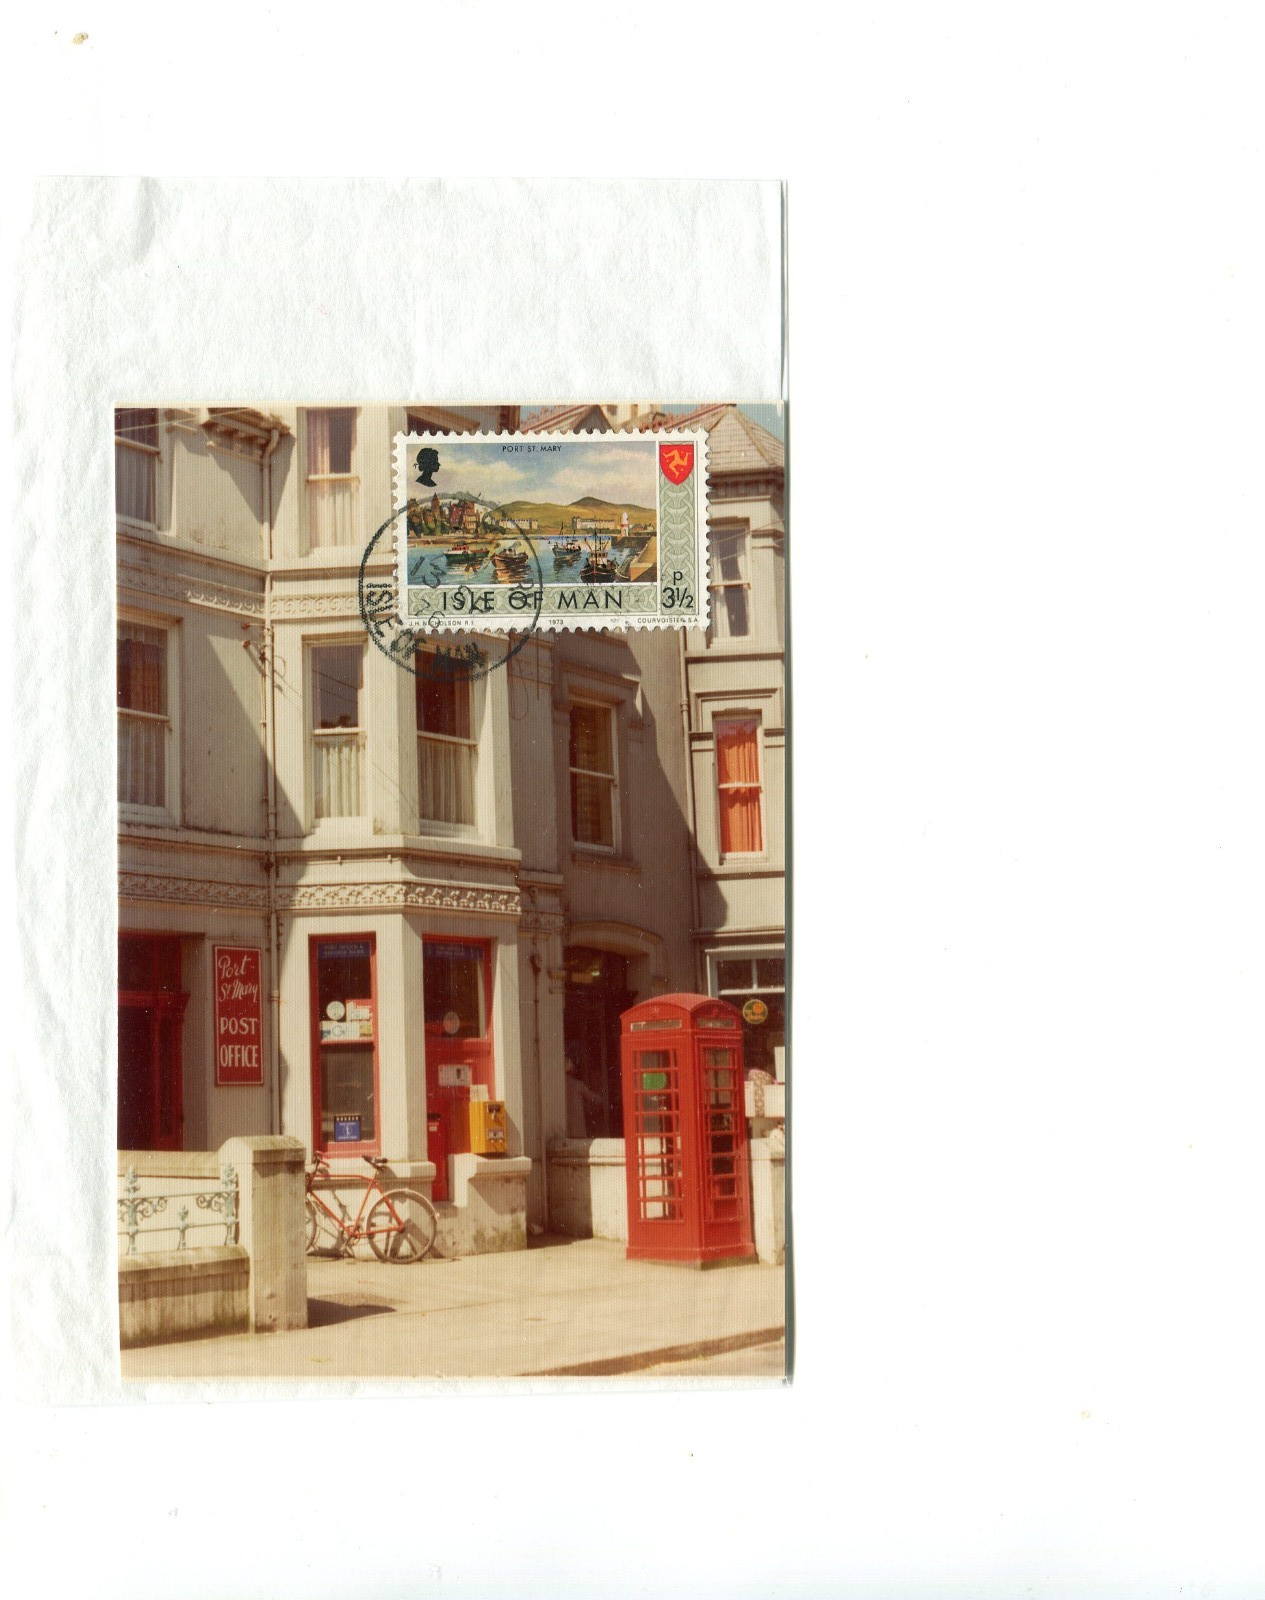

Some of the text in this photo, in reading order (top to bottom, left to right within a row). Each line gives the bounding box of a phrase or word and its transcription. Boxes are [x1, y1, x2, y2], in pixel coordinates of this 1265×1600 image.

[502, 445, 523, 453] PORT
[540, 445, 562, 453] MARY
[442, 590, 498, 610] ISLE
[508, 590, 543, 610] OF
[558, 590, 622, 609] MAN
[218, 954, 251, 979] Port
[231, 980, 258, 1003] Mary
[220, 1017, 258, 1035] POST
[220, 1044, 259, 1067] OFFICE
